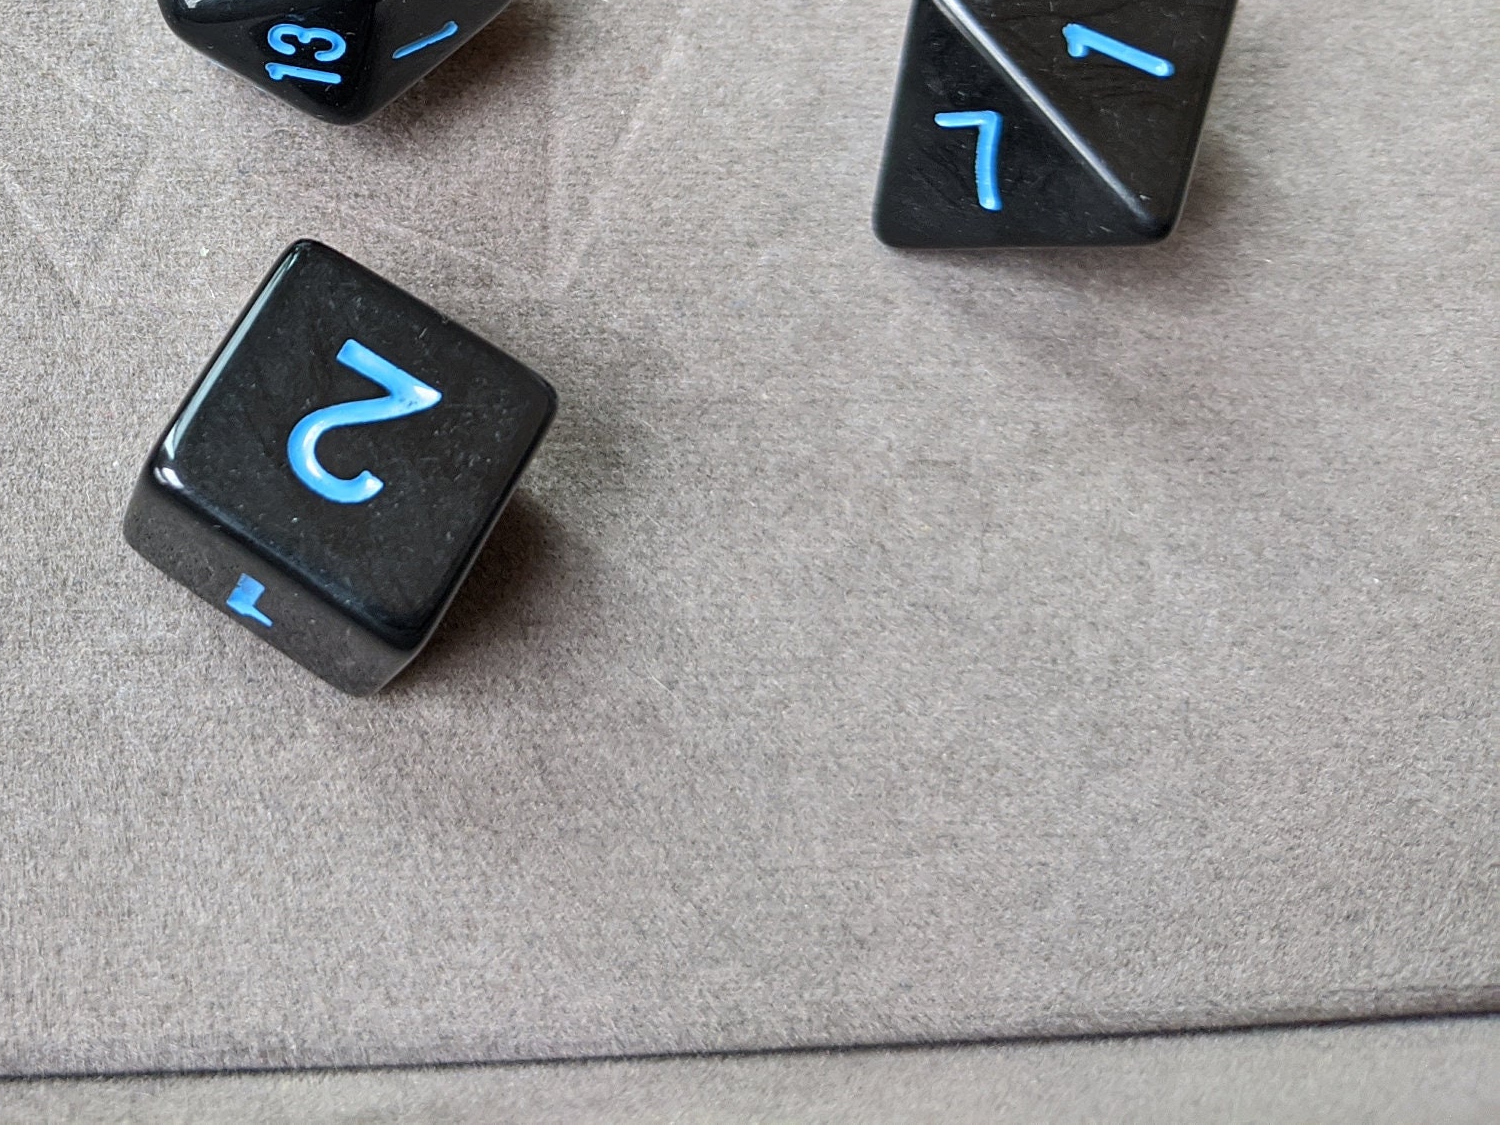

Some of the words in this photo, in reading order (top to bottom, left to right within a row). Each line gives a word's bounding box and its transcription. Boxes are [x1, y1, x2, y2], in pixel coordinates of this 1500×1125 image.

[264, 23, 347, 86] 13
[1062, 22, 1175, 79] 1
[933, 109, 1004, 213] 7
[286, 338, 443, 505] 2
